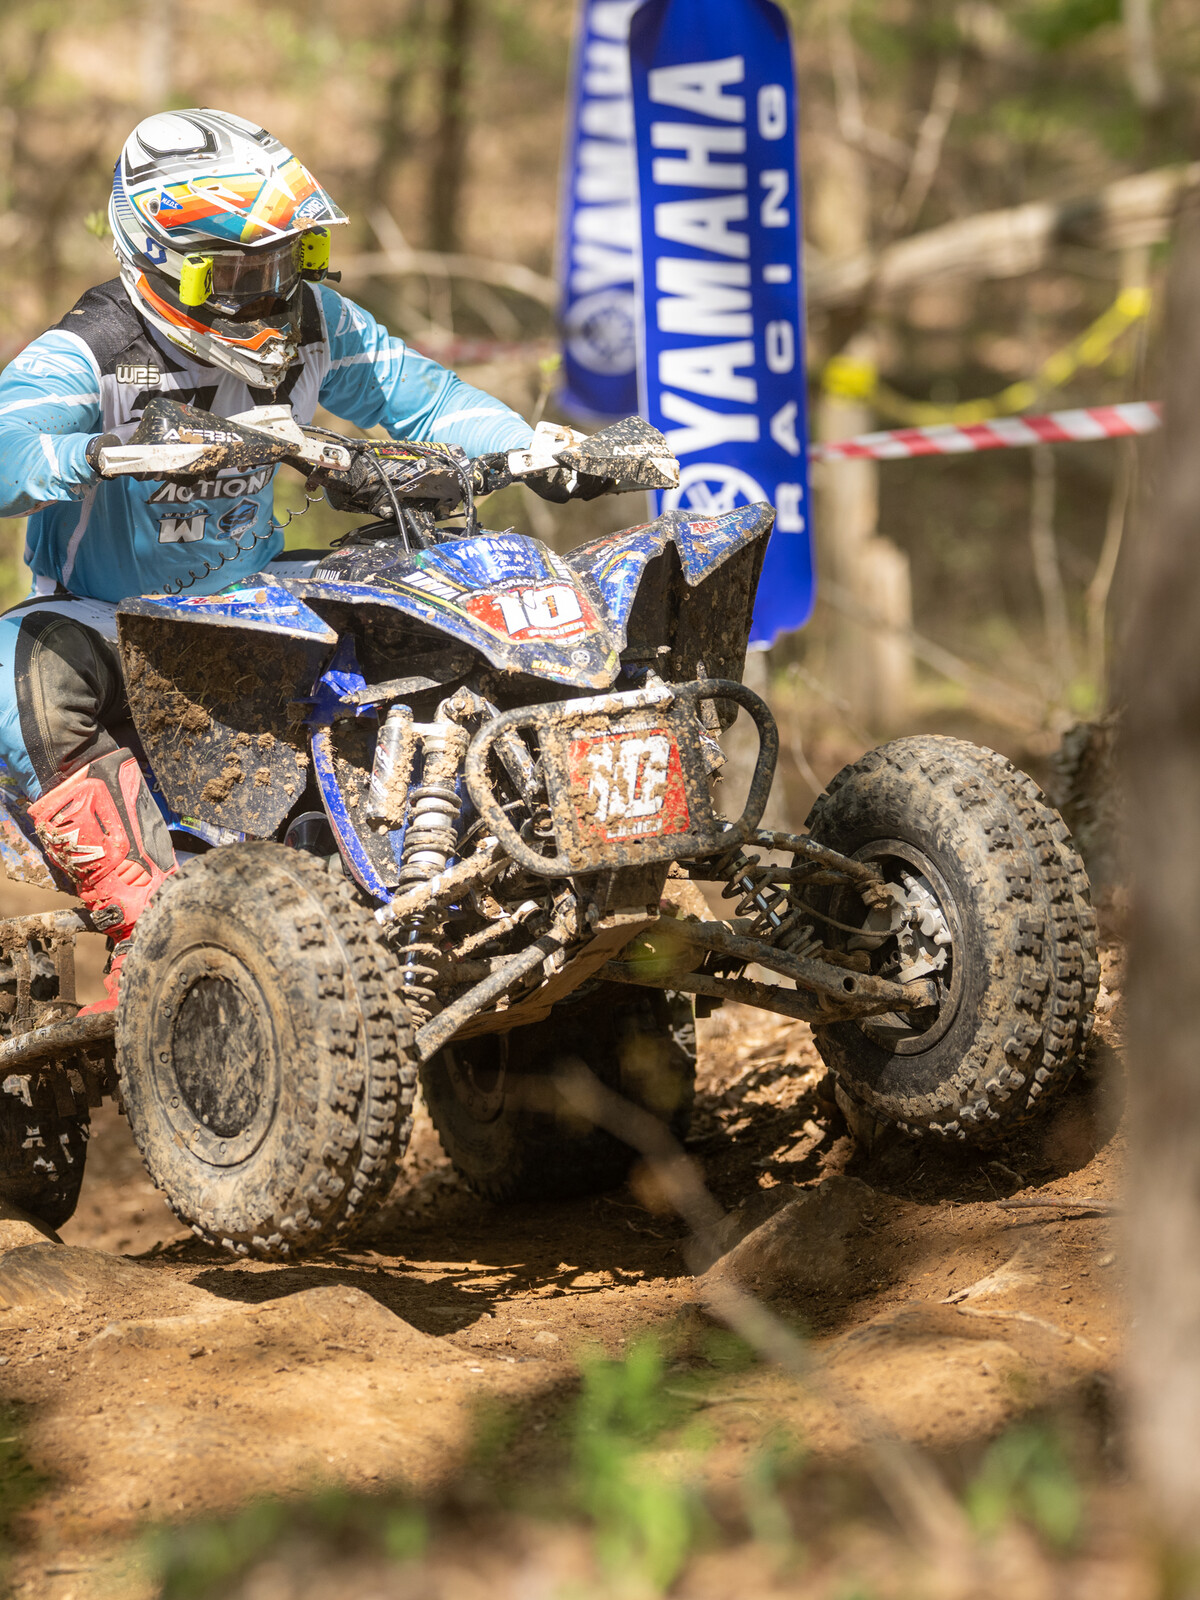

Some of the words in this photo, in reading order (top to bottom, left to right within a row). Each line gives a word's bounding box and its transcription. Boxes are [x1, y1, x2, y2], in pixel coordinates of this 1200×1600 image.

[648, 55, 760, 456] YAMAHA
[757, 83, 805, 534] RACING
[116, 364, 160, 384] WPS
[153, 470, 266, 502] ACTION
[454, 540, 524, 560] YAMAHA
[490, 586, 584, 637] 10
